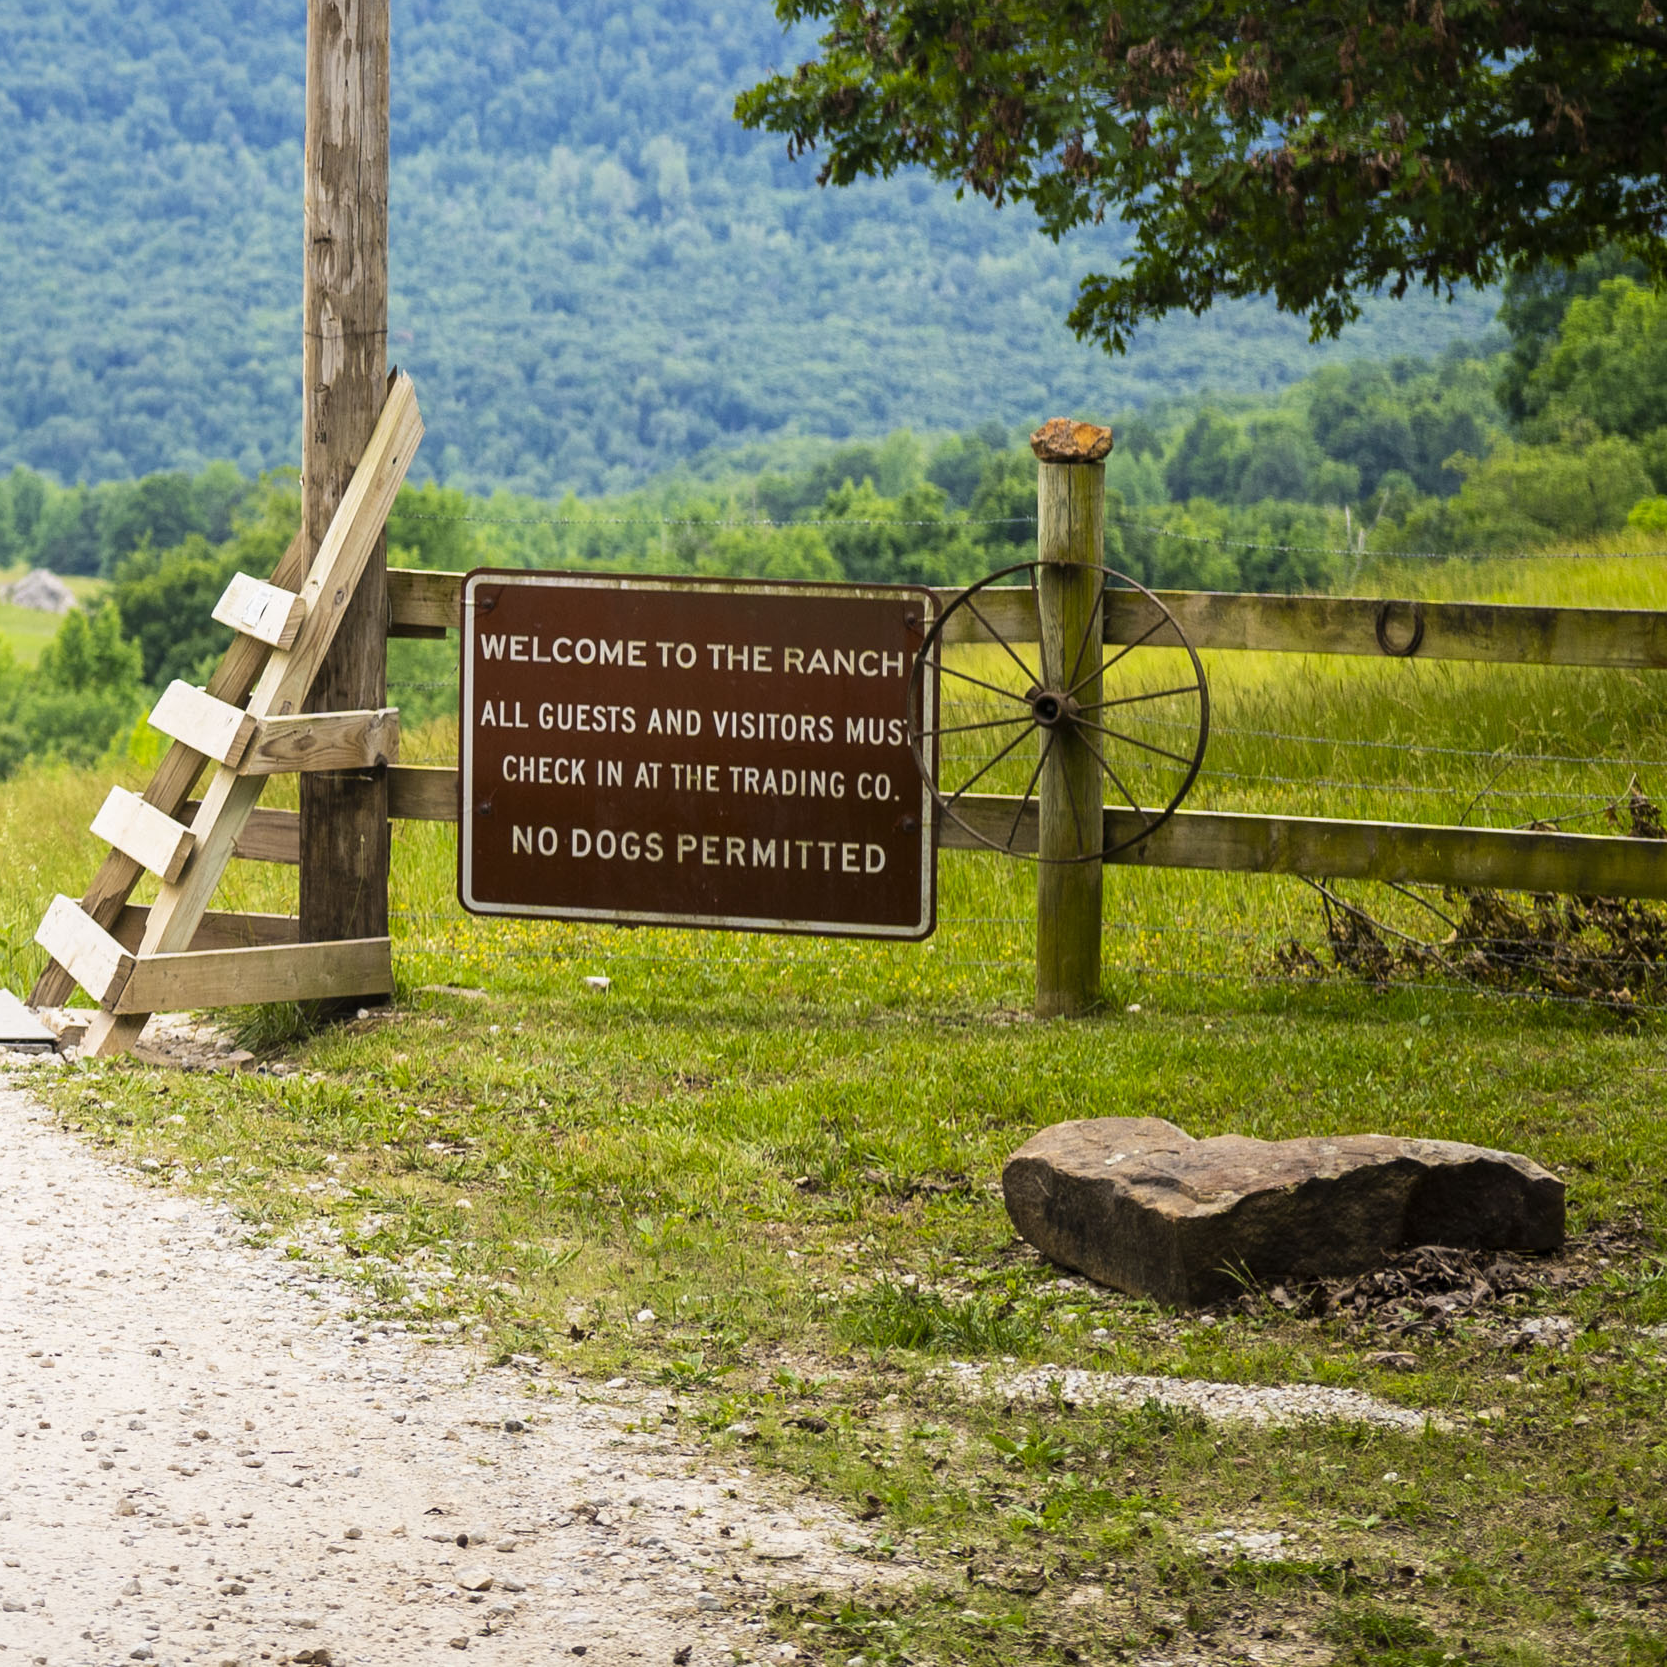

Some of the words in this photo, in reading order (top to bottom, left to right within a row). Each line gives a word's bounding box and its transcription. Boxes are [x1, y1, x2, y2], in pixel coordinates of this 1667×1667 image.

[480, 633, 647, 667] WELCOME
[655, 641, 697, 669] TO
[706, 643, 773, 672] THE
[480, 699, 529, 728] ALL
[538, 702, 636, 734] GUESTS
[647, 707, 702, 736] AND
[712, 710, 834, 743] VISITORS
[502, 755, 586, 786] CHECK
[597, 760, 623, 788] IN
[634, 762, 663, 789] AT
[670, 763, 720, 792] THE
[728, 766, 845, 798] TRADING
[857, 773, 900, 802] CO.
[512, 825, 558, 856] NO
[571, 828, 664, 862] DOGS
[677, 835, 886, 873] PERMITTED
